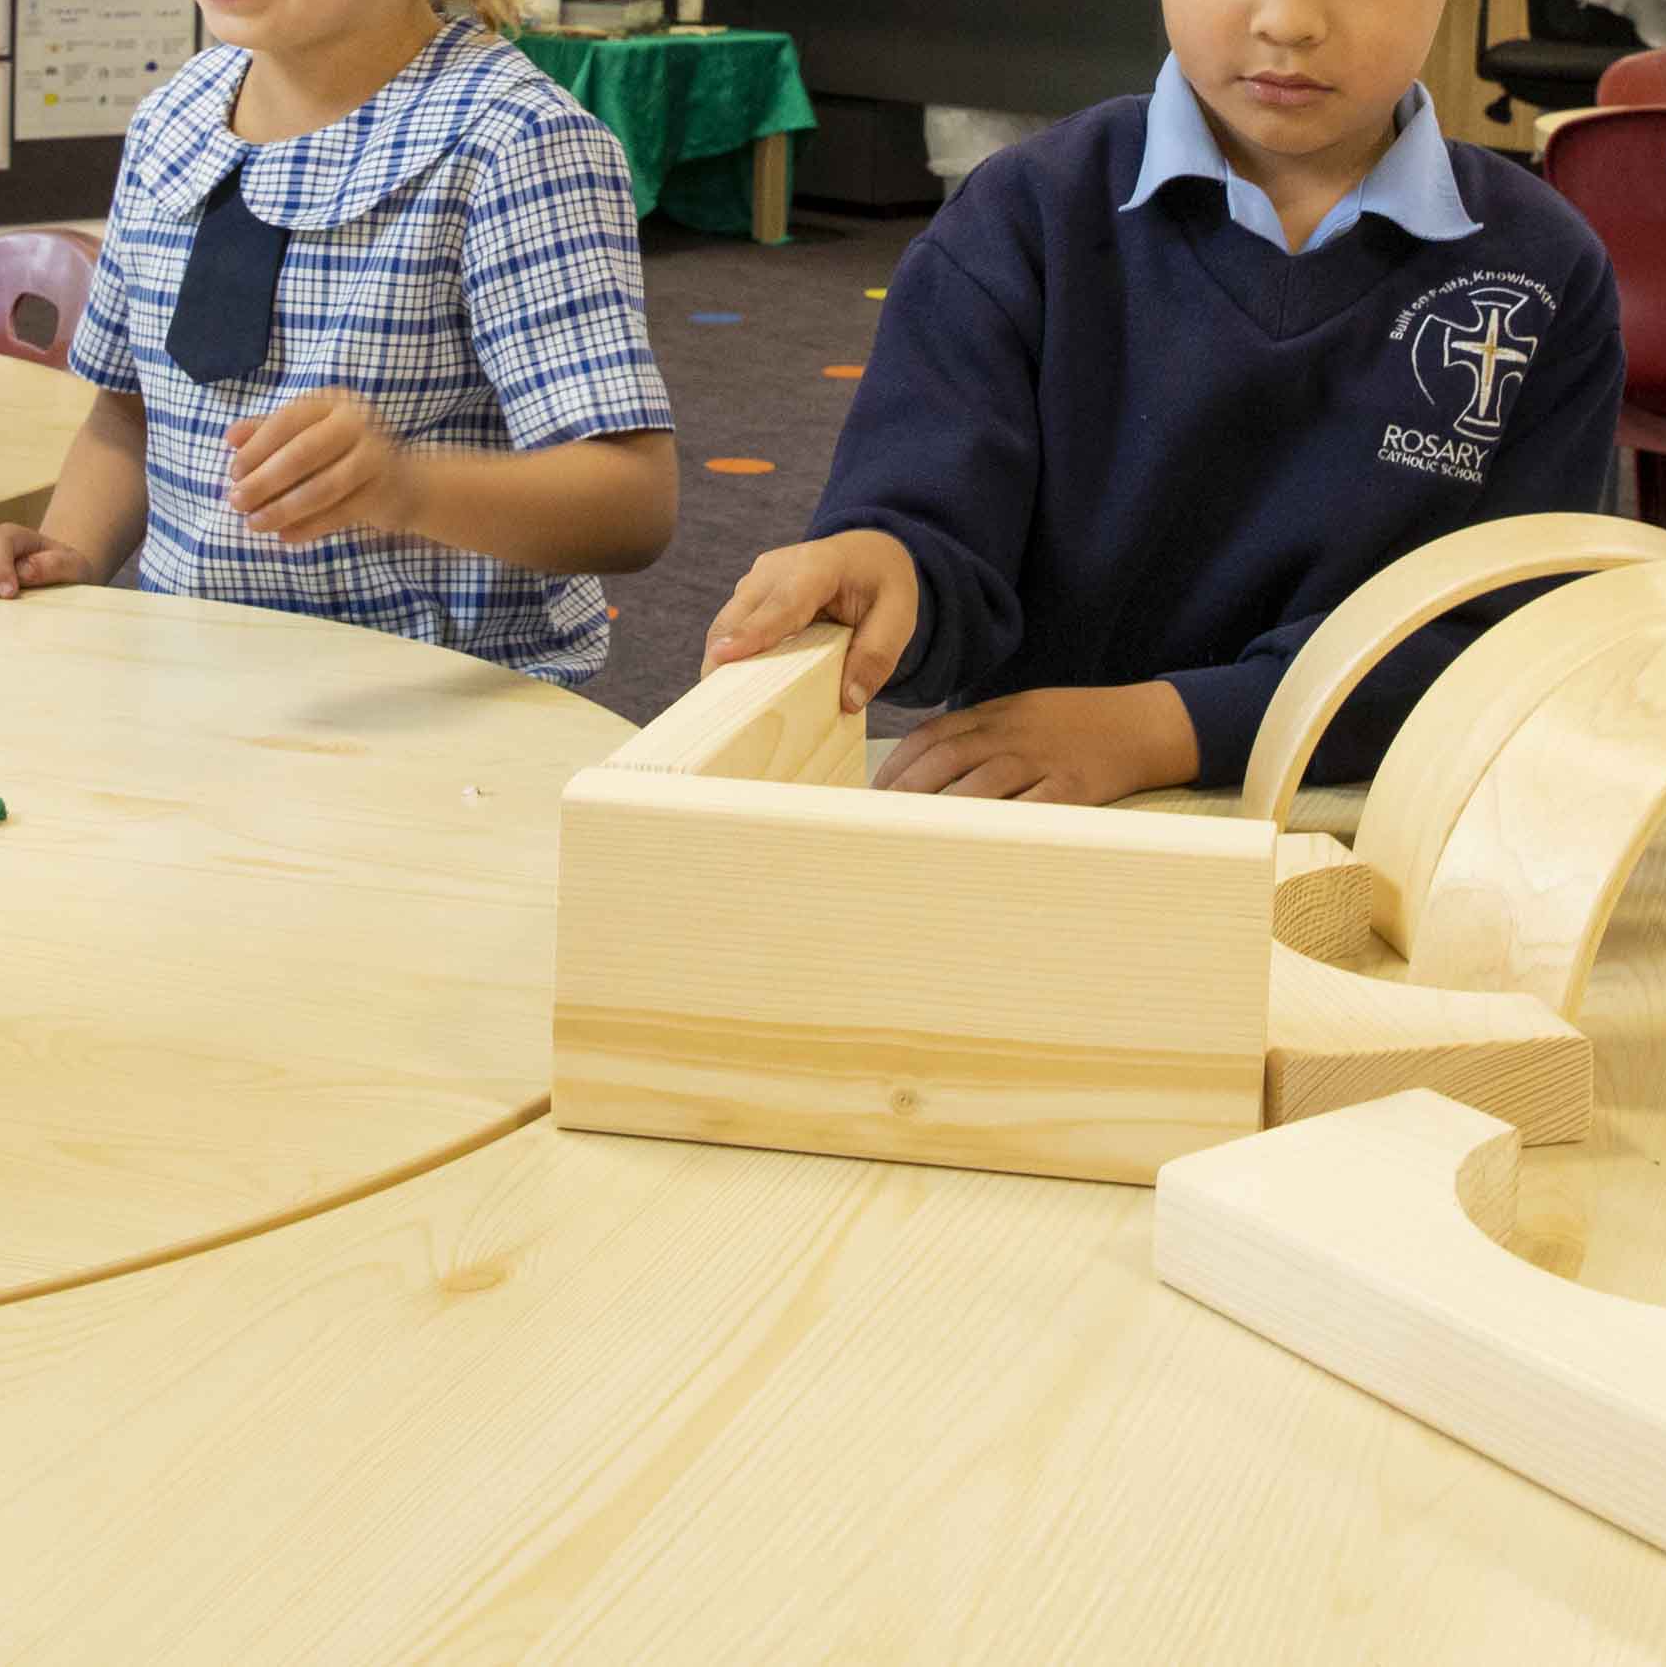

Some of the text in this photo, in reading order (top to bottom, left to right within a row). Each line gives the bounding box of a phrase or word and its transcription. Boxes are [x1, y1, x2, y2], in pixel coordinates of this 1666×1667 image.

[1389, 309, 1416, 340] Built
[1412, 295, 1430, 311] on
[1378, 448, 1439, 472] CATHOLIC
[1383, 424, 1490, 470] ROSARY
